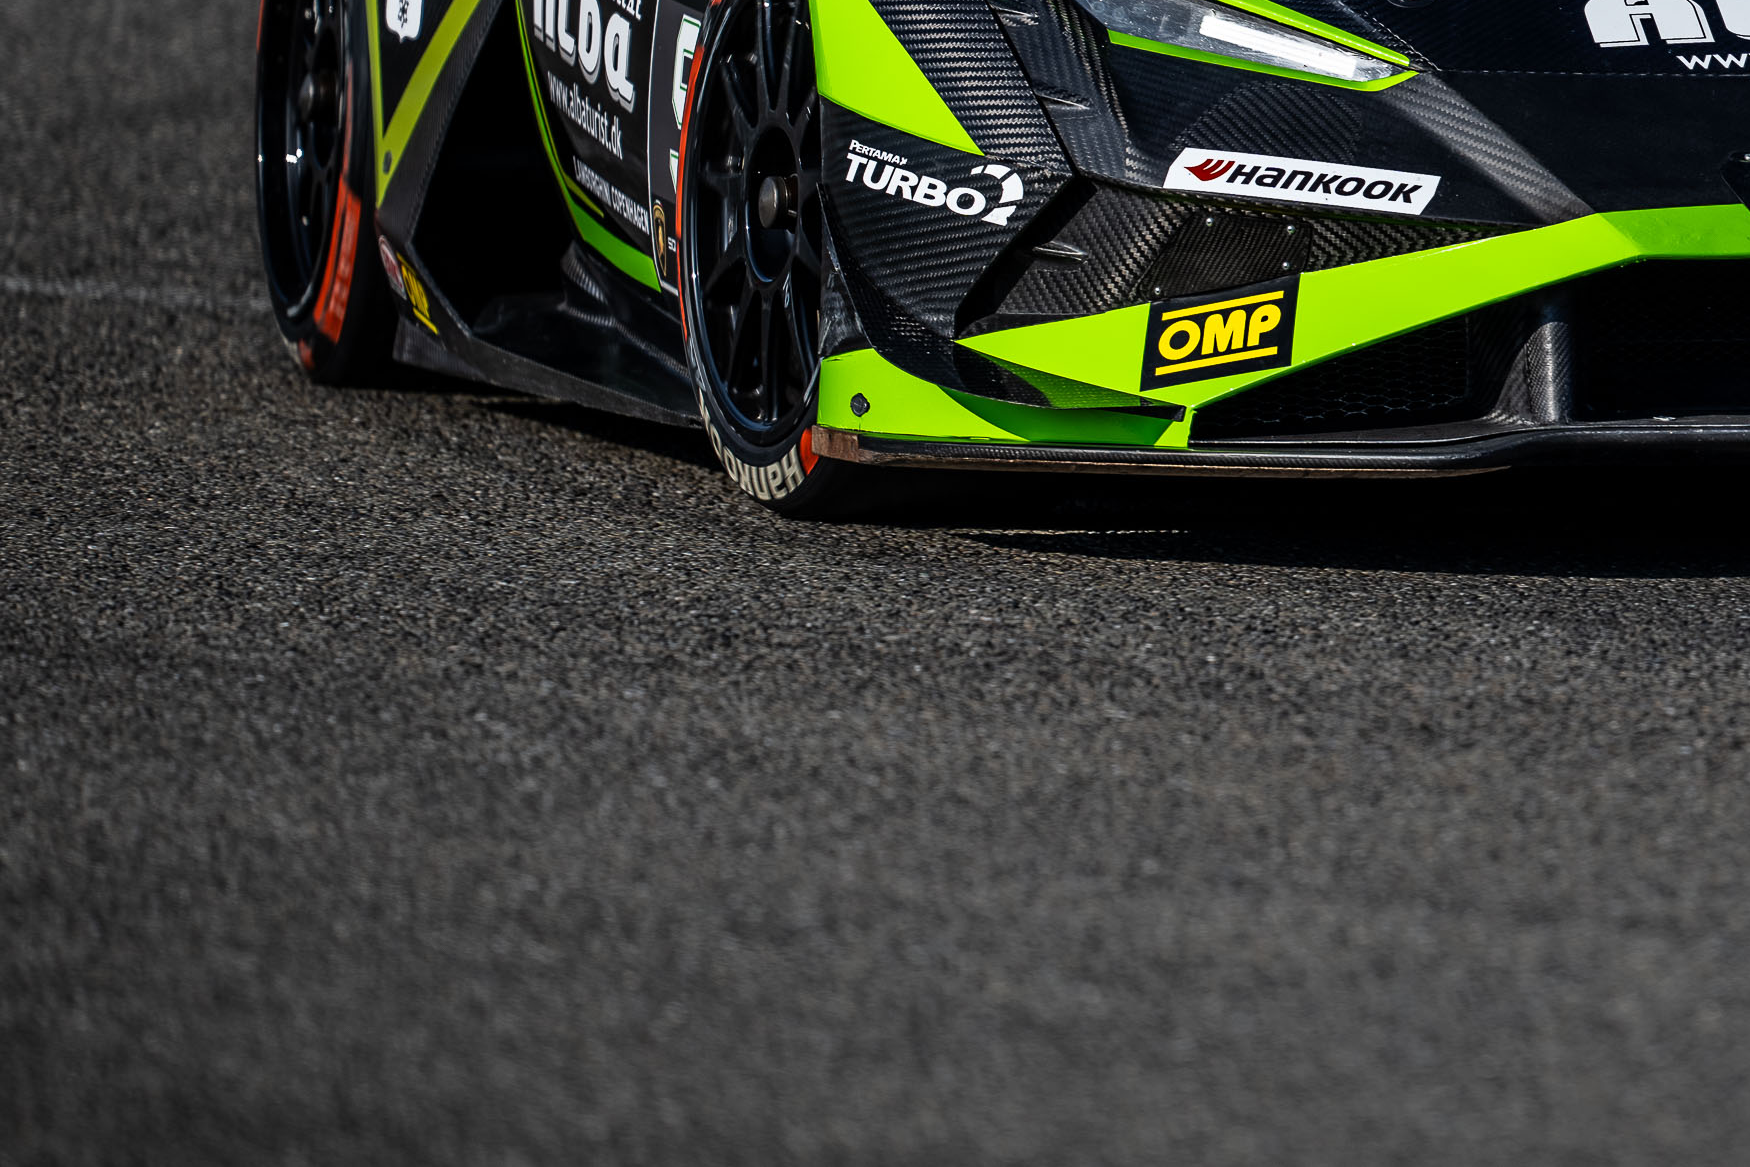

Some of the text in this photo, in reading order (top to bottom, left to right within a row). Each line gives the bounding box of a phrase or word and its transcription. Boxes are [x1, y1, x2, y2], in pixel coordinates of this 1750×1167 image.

[547, 69, 623, 161] www.albaturist.dk
[611, 185, 650, 236] COPENHAGEN
[1157, 303, 1282, 361] OMP
